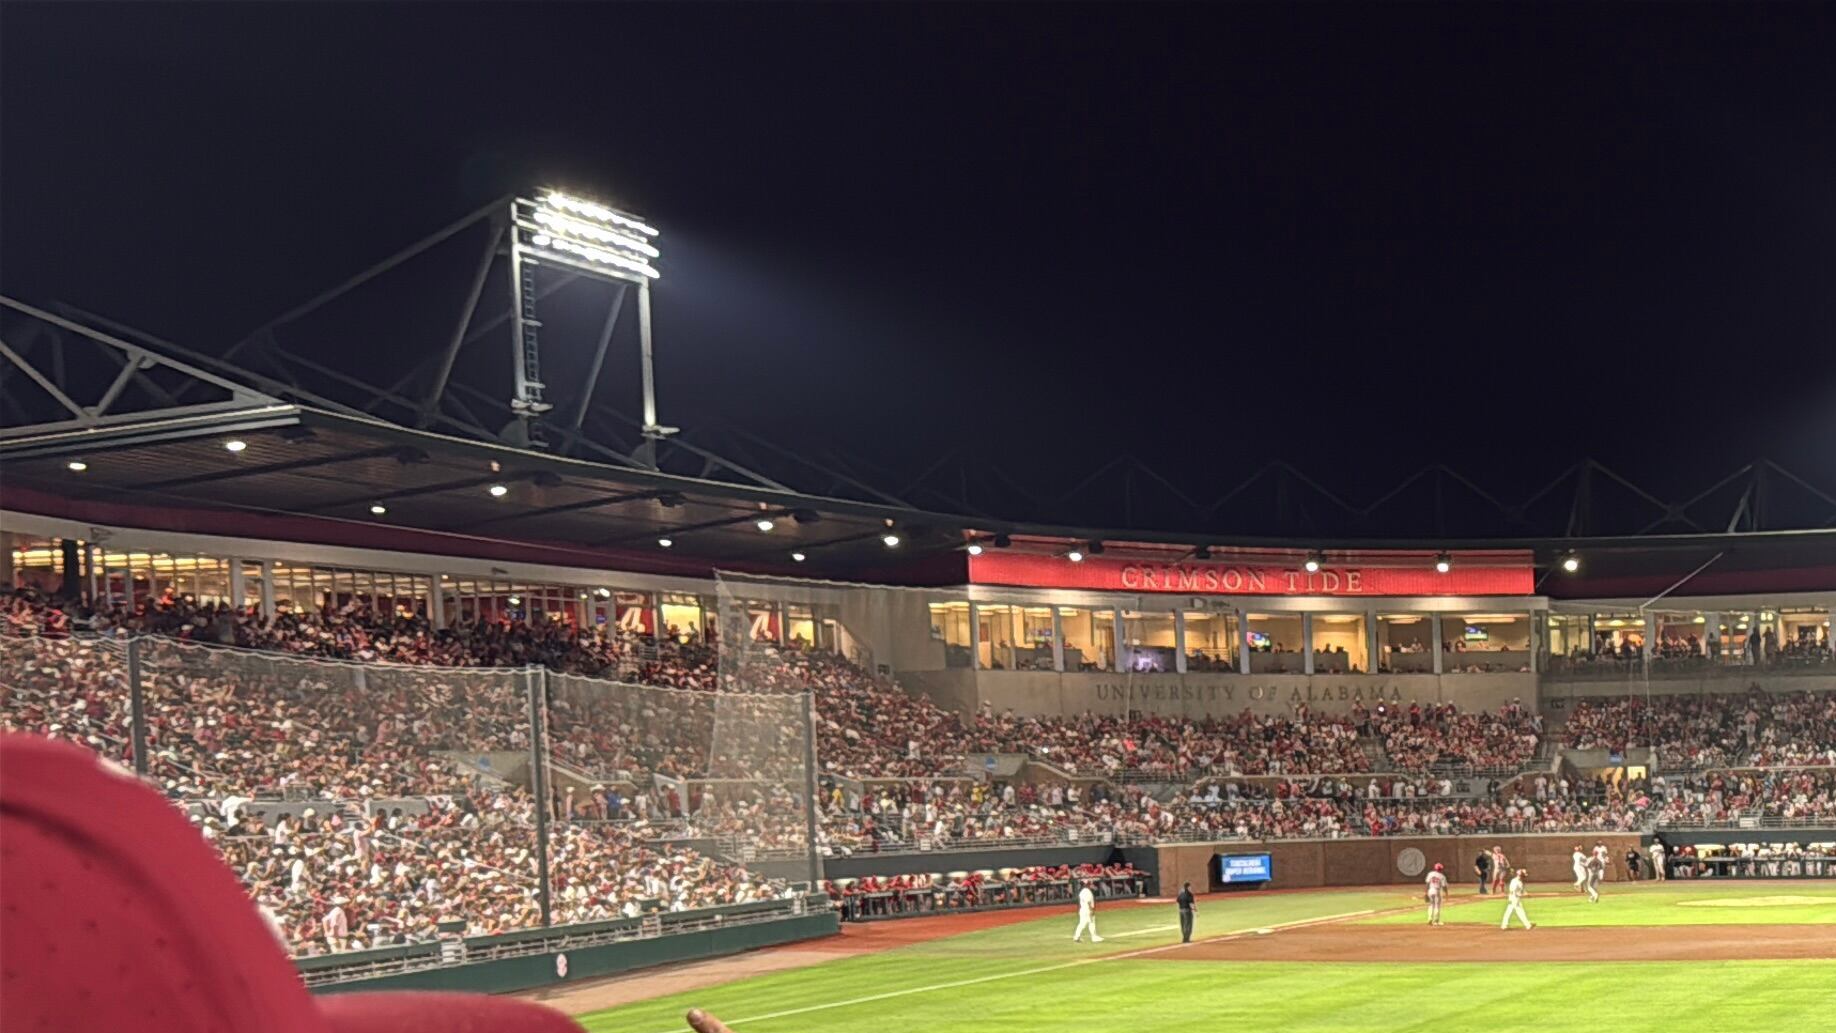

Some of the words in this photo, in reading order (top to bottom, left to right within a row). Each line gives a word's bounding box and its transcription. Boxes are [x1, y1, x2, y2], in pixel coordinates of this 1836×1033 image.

[1121, 566, 1266, 591] CRIMSON
[1284, 571, 1363, 593] TIDE
[1096, 684, 1235, 700] UNIVERSITY
[1250, 685, 1277, 700] OF
[1290, 685, 1401, 701] ALABAMA
